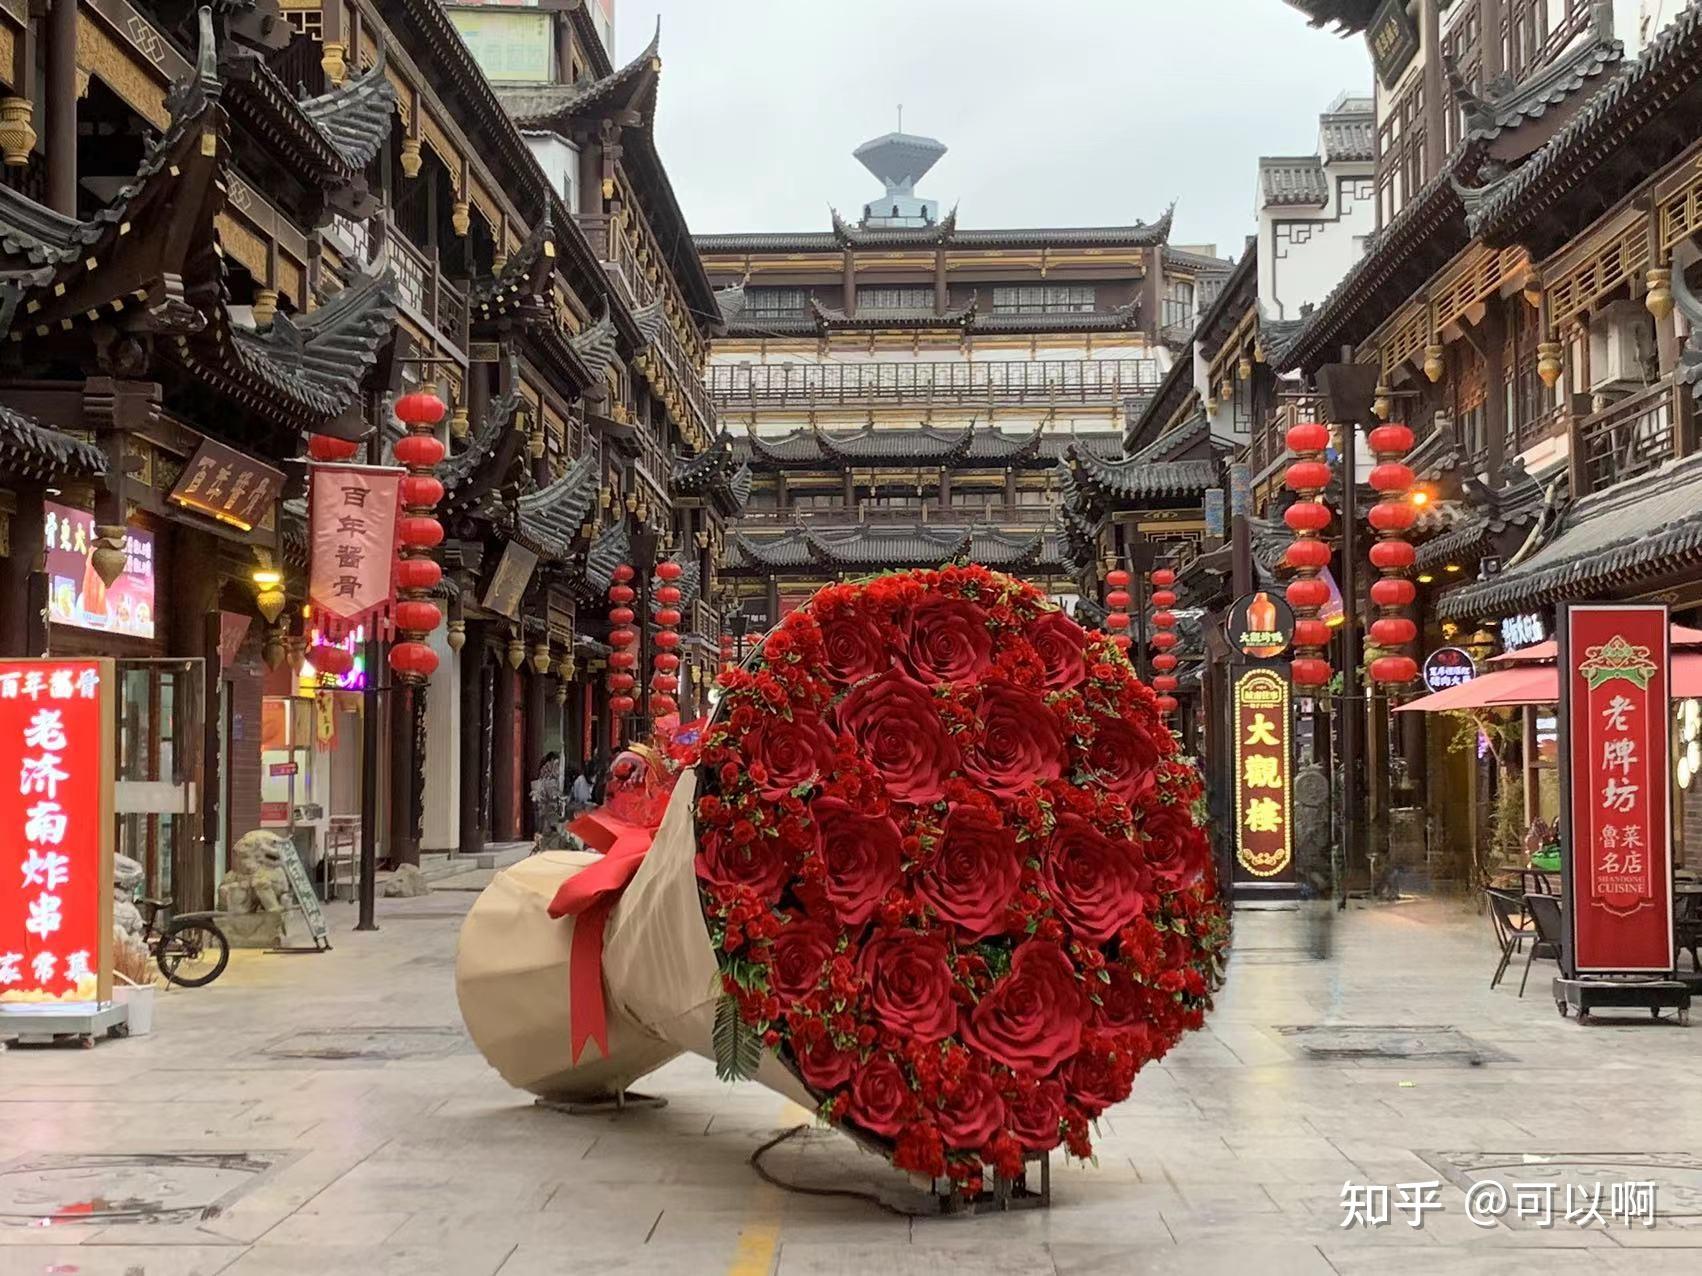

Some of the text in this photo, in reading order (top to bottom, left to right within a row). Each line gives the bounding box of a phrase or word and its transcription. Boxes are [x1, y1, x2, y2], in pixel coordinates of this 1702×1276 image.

[1602, 694, 1639, 812] 老牌坊
[19, 708, 70, 941] 老济南炸串
[1597, 883, 1645, 894] CUISINE
